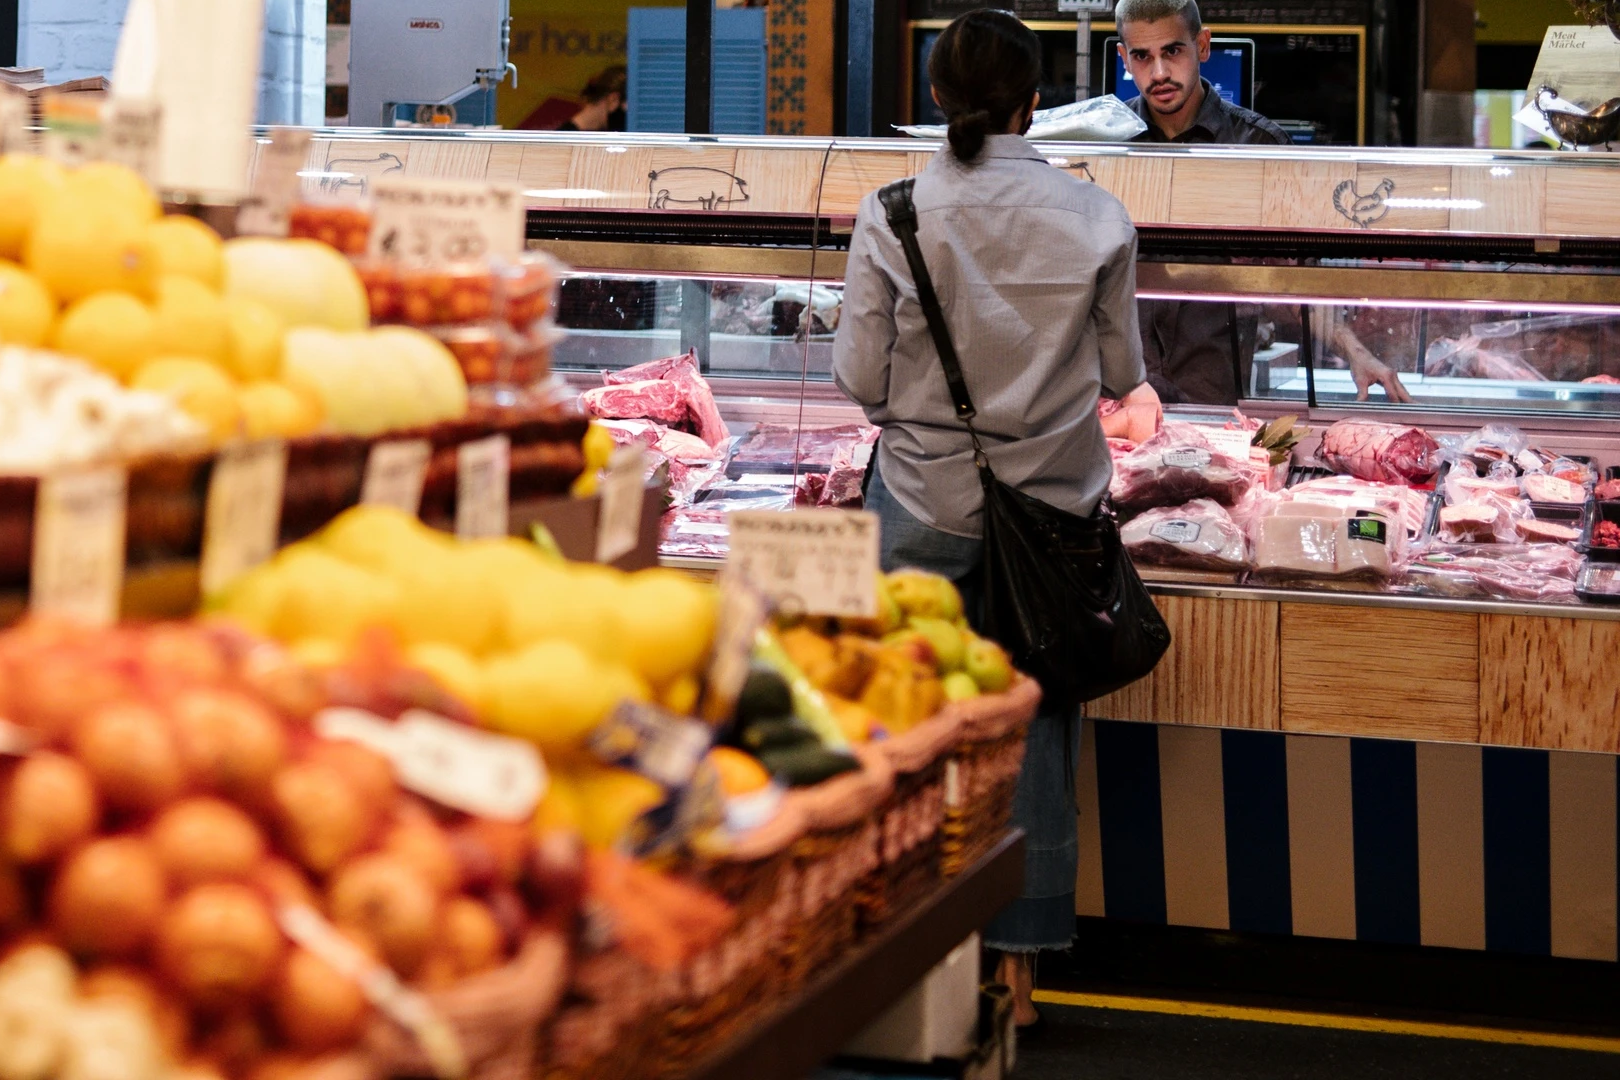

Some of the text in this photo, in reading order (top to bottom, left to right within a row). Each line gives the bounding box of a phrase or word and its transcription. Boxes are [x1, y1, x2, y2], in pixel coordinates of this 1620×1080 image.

[1551, 31, 1576, 40] Meat
[1286, 35, 1334, 52] STALL
[1548, 40, 1585, 49] Market
